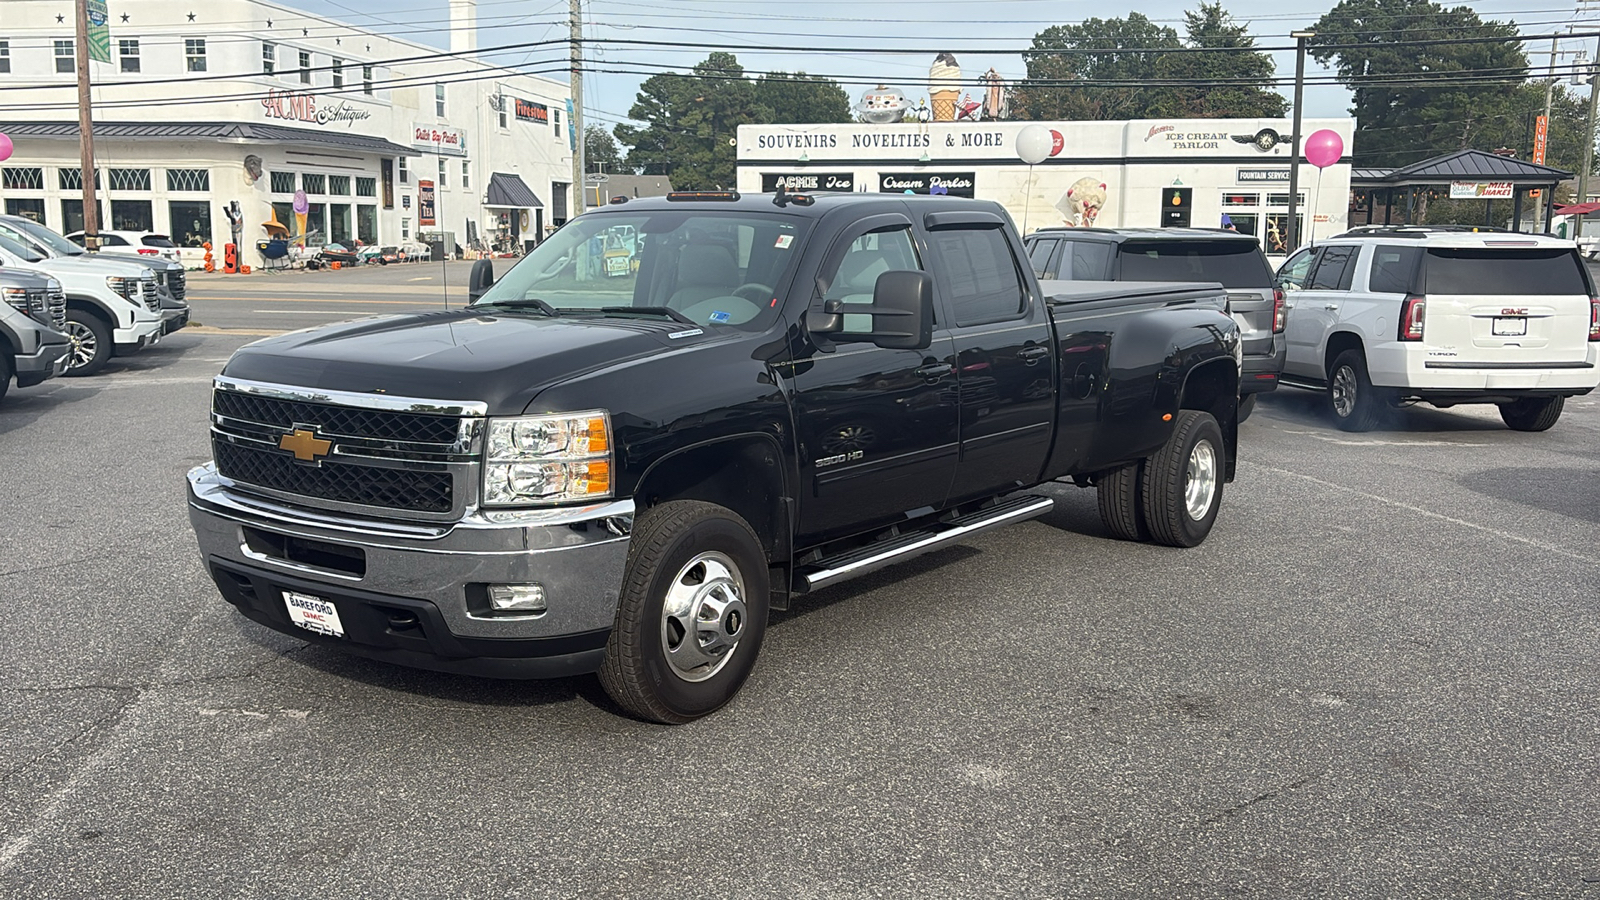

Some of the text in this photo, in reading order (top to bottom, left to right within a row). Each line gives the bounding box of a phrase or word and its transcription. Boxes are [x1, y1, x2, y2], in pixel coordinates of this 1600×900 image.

[261, 88, 371, 127] ACME Antiques
[515, 98, 547, 120] Firestone
[442, 131, 458, 144] Paints
[1537, 117, 1546, 150] ACME
[758, 132, 1003, 149] SOUVENIRS NOVELTIES & MORE
[1173, 141, 1219, 149] PARLOR
[776, 176, 851, 188] ACME Ice
[882, 176, 972, 188] Cream Parlor
[1239, 171, 1290, 180] FOUNTAIN SERVICE
[422, 205, 434, 217] TEA
[815, 450, 863, 468] 3500 HD
[288, 596, 333, 616] BAREFORD
[302, 610, 326, 623] GMC
